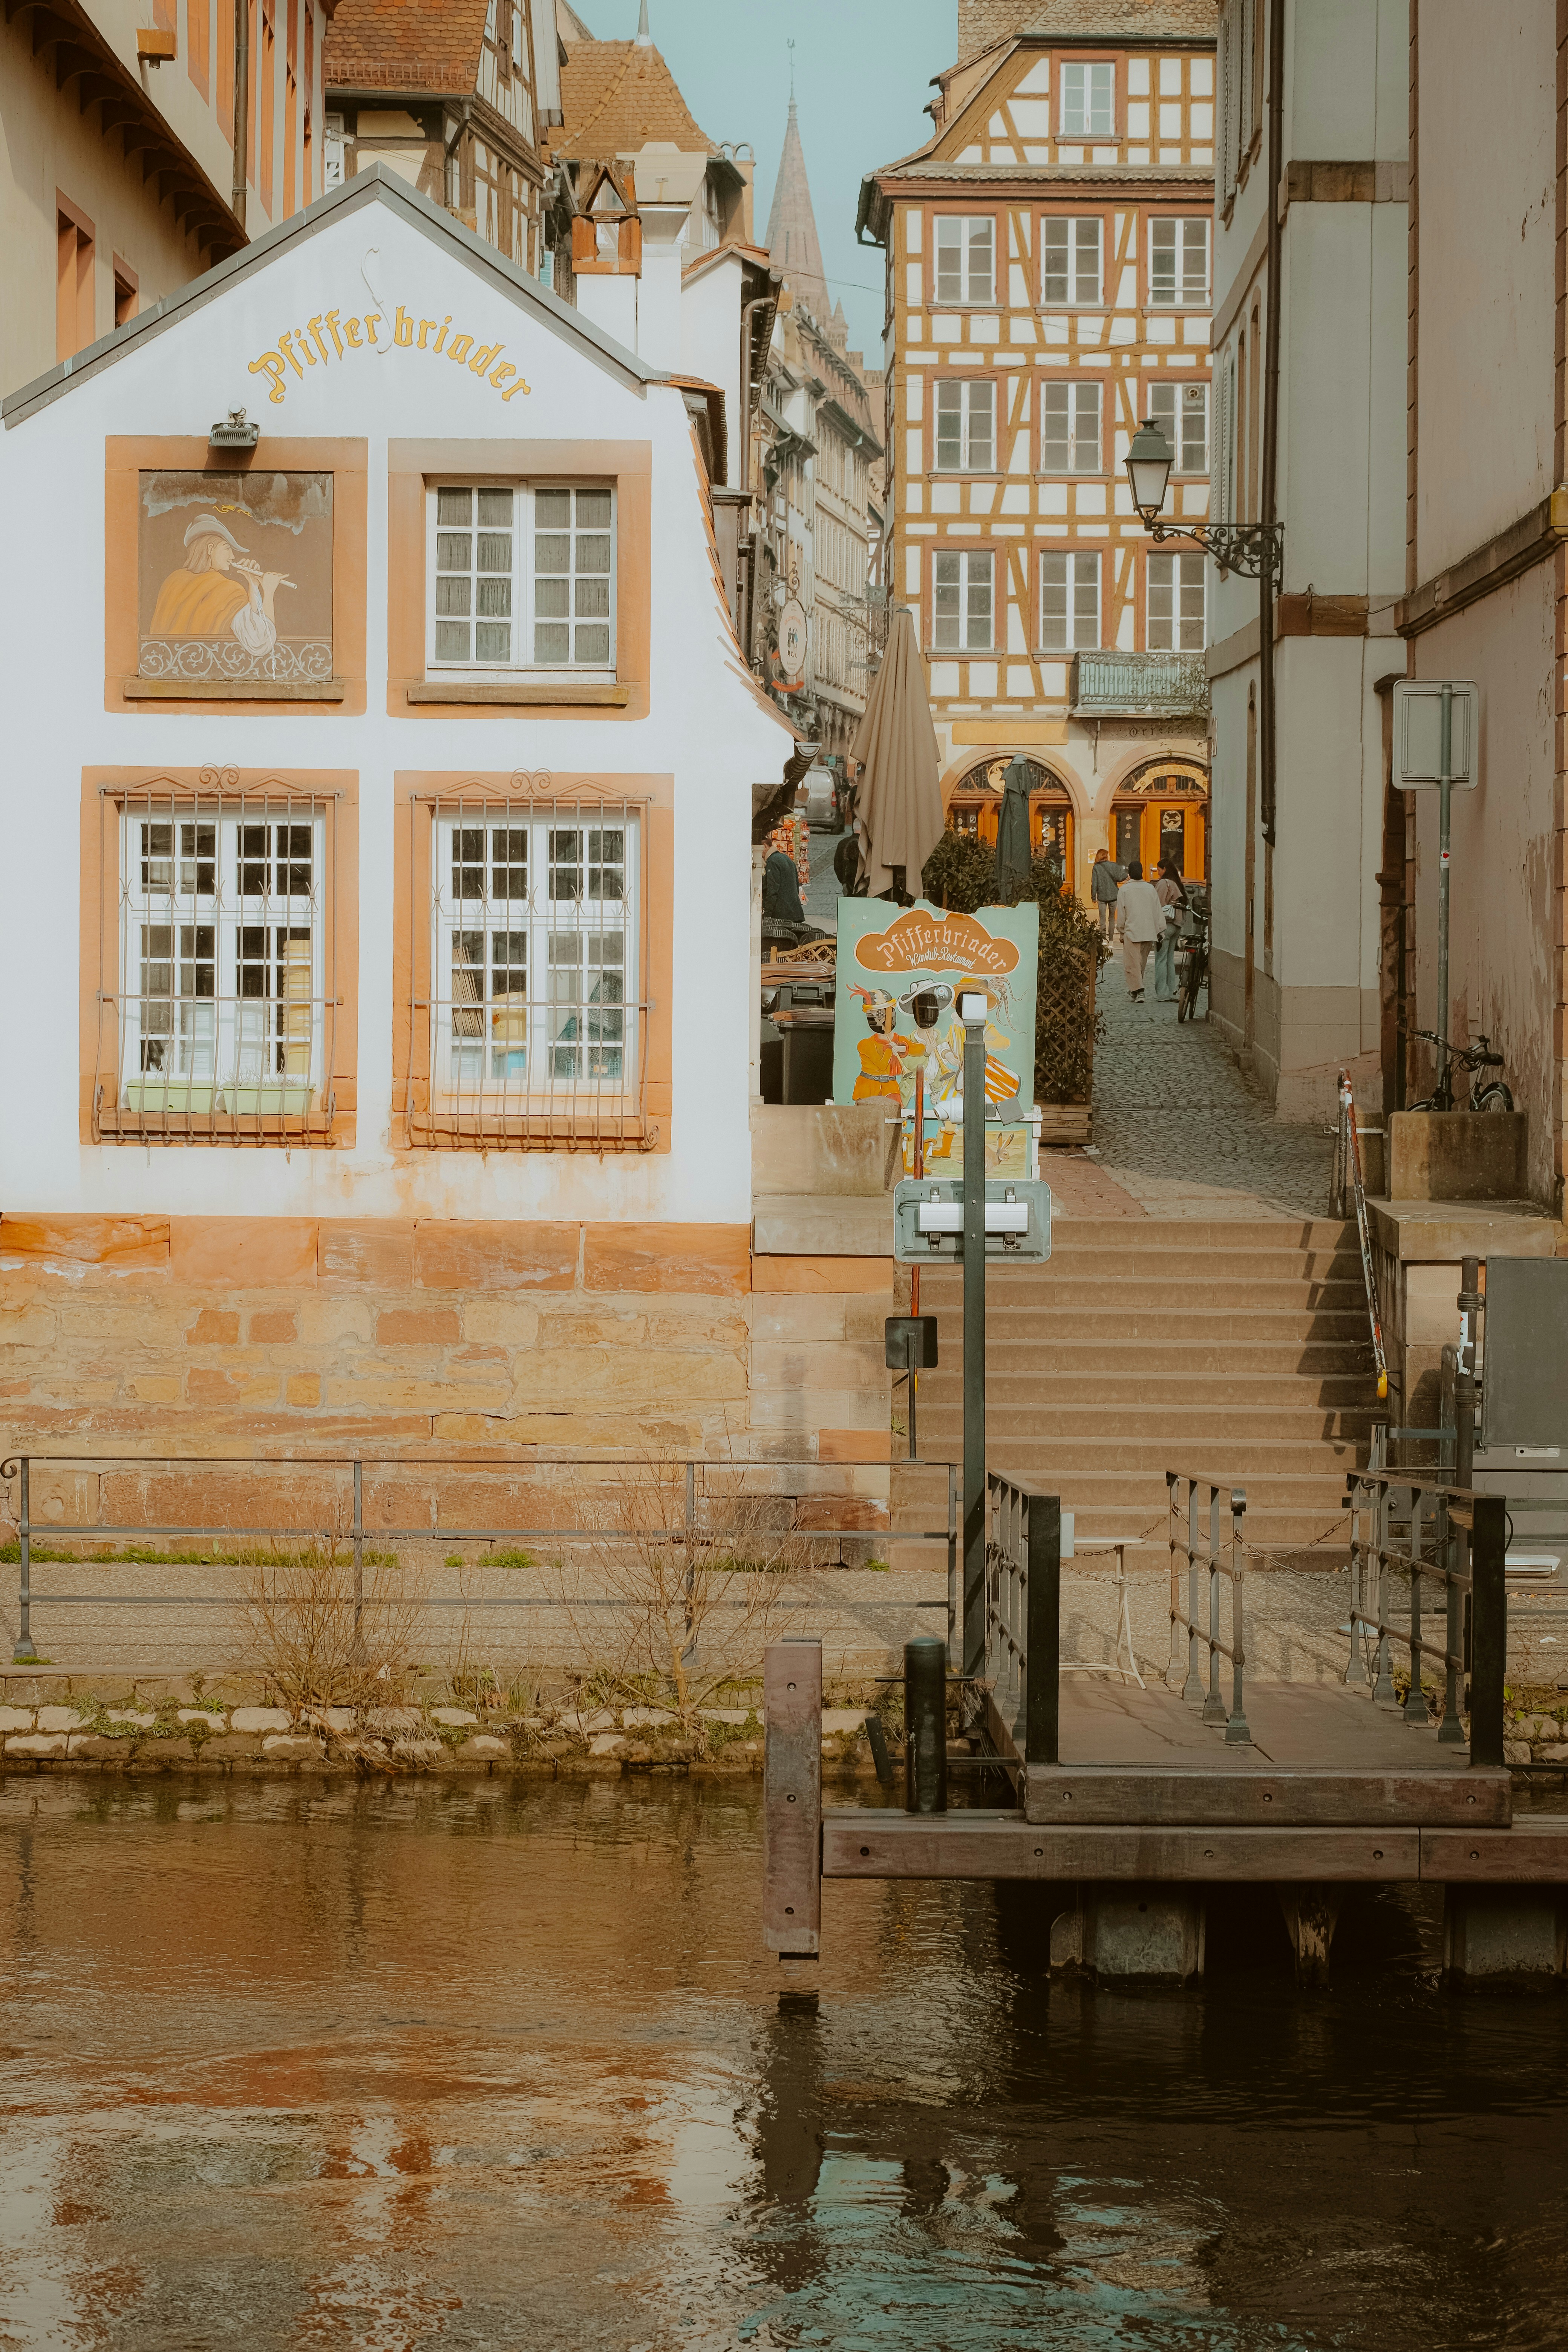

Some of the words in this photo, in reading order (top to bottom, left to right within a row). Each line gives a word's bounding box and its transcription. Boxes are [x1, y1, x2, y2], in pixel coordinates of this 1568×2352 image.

[876, 925, 1006, 970] Pfifferbriader
[906, 946, 939, 968] Winstub
[937, 946, 977, 969] Restaurant
